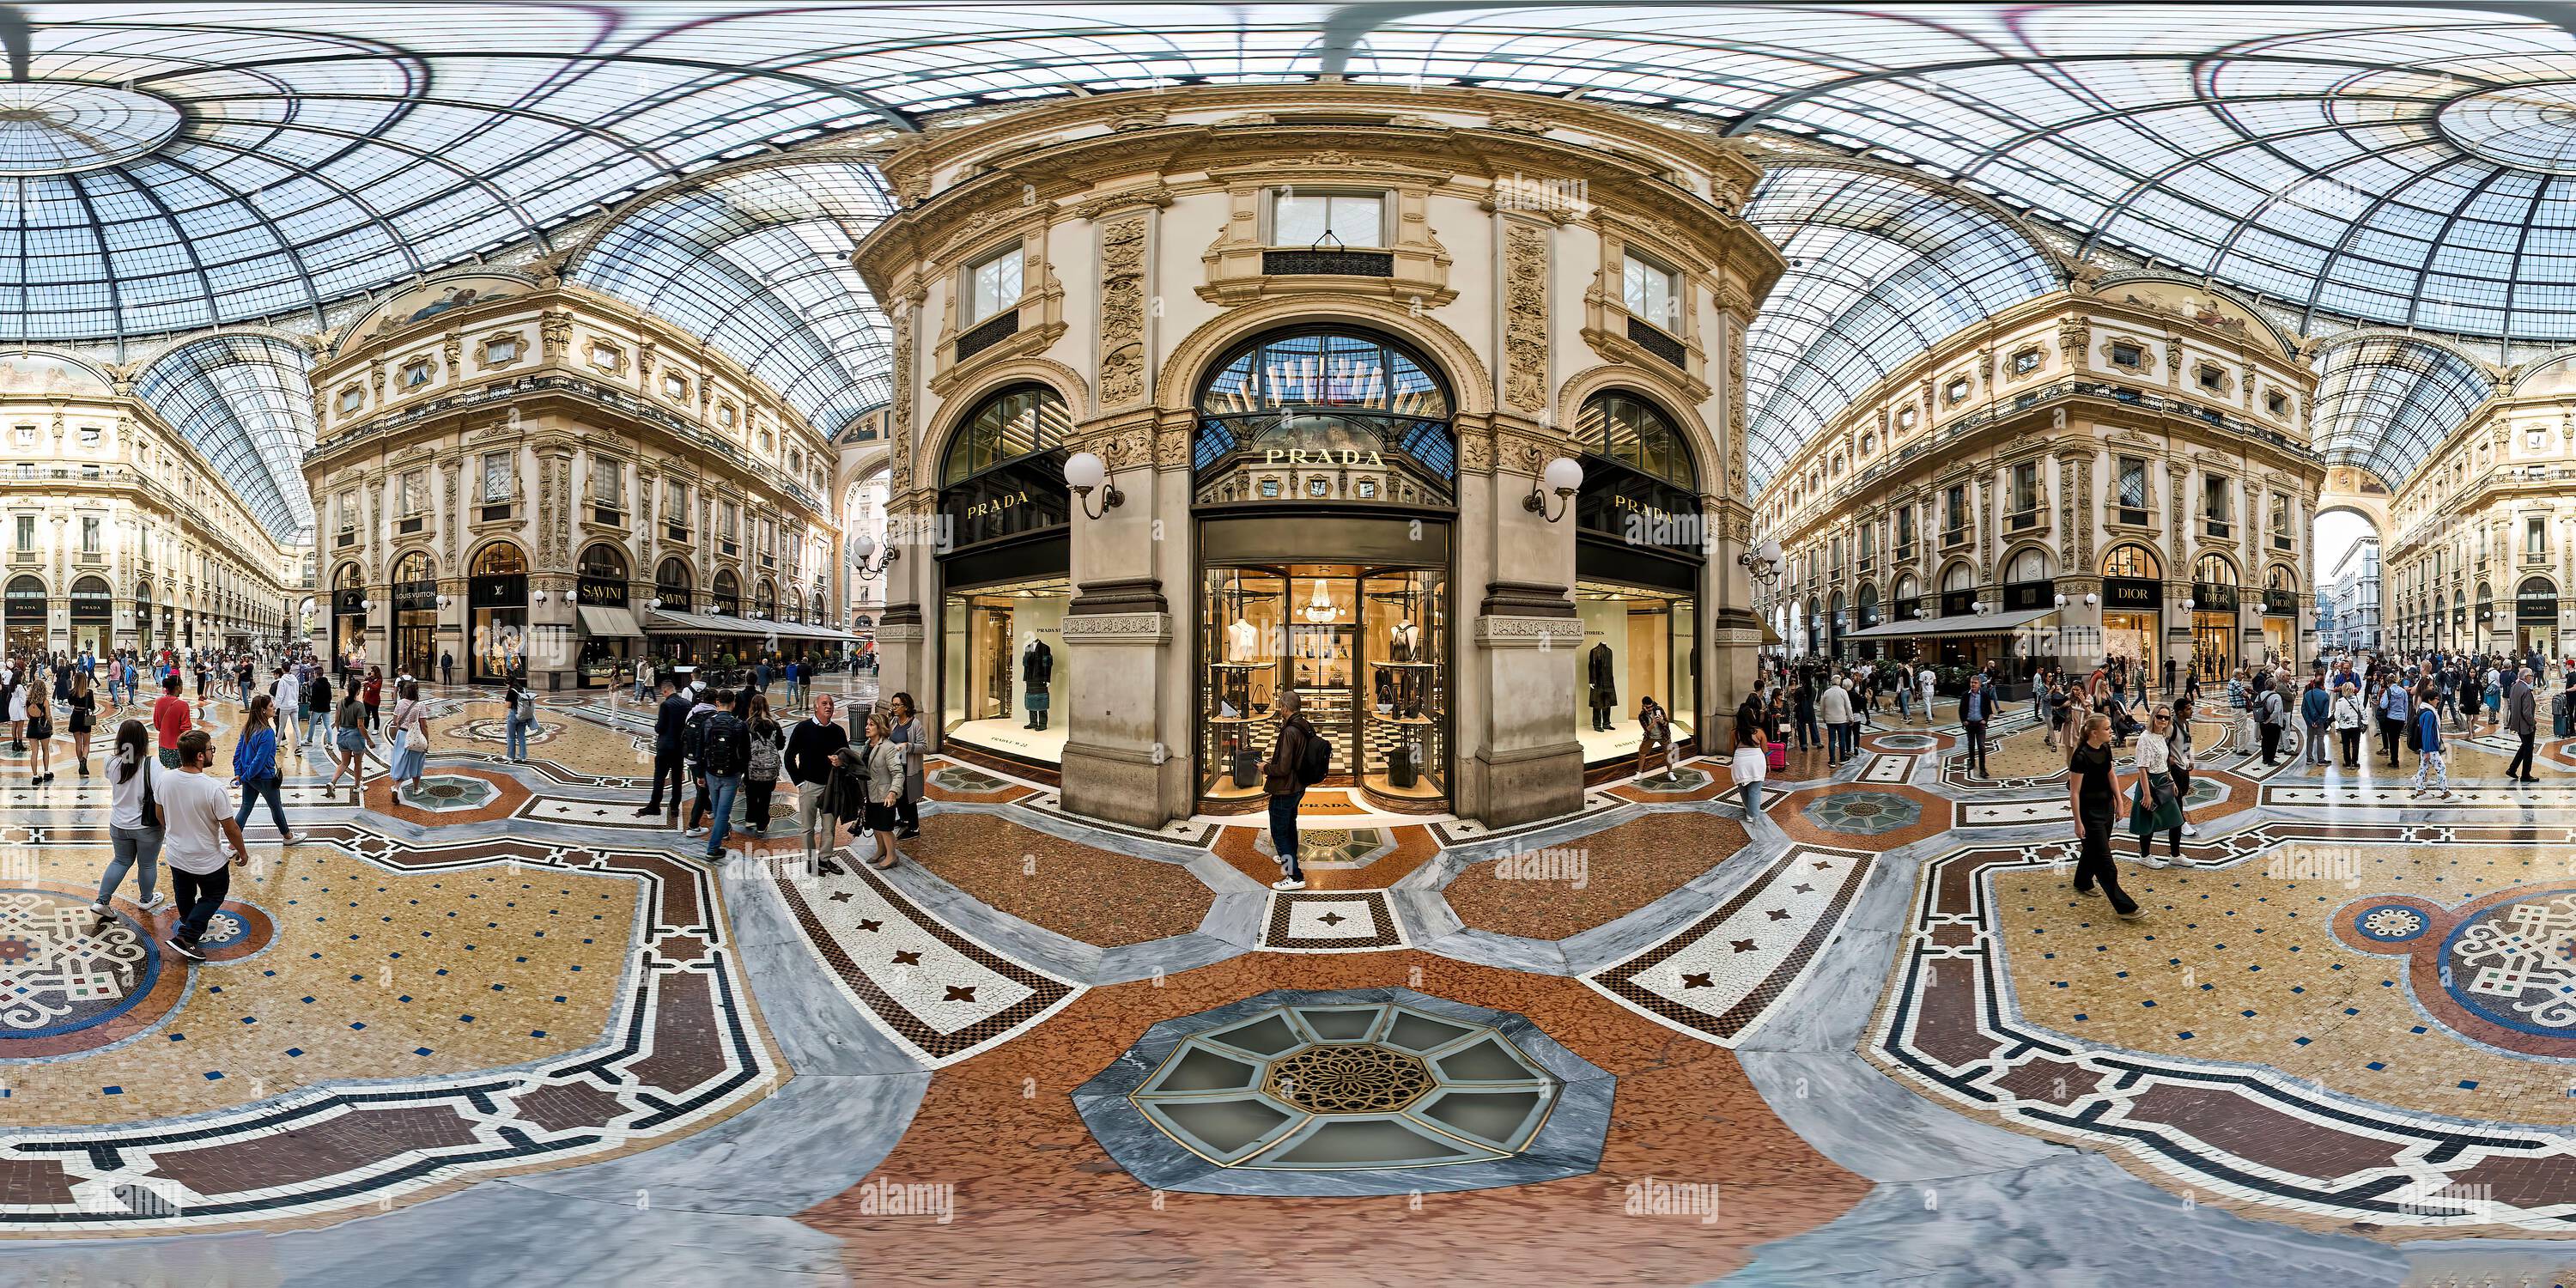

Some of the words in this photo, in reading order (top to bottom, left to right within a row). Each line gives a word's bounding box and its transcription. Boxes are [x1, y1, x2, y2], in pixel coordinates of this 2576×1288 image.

[1266, 447, 1385, 466] PRADA
[967, 489, 1030, 519] PRADA
[1614, 494, 1674, 525] PRADA
[411, 590, 436, 598] VUITTON
[582, 584, 621, 599] SAVINI
[2118, 587, 2148, 599] DIOR
[2204, 592, 2229, 604] DIOR
[658, 592, 687, 605] SAVINI
[2272, 598, 2291, 608] DIOR
